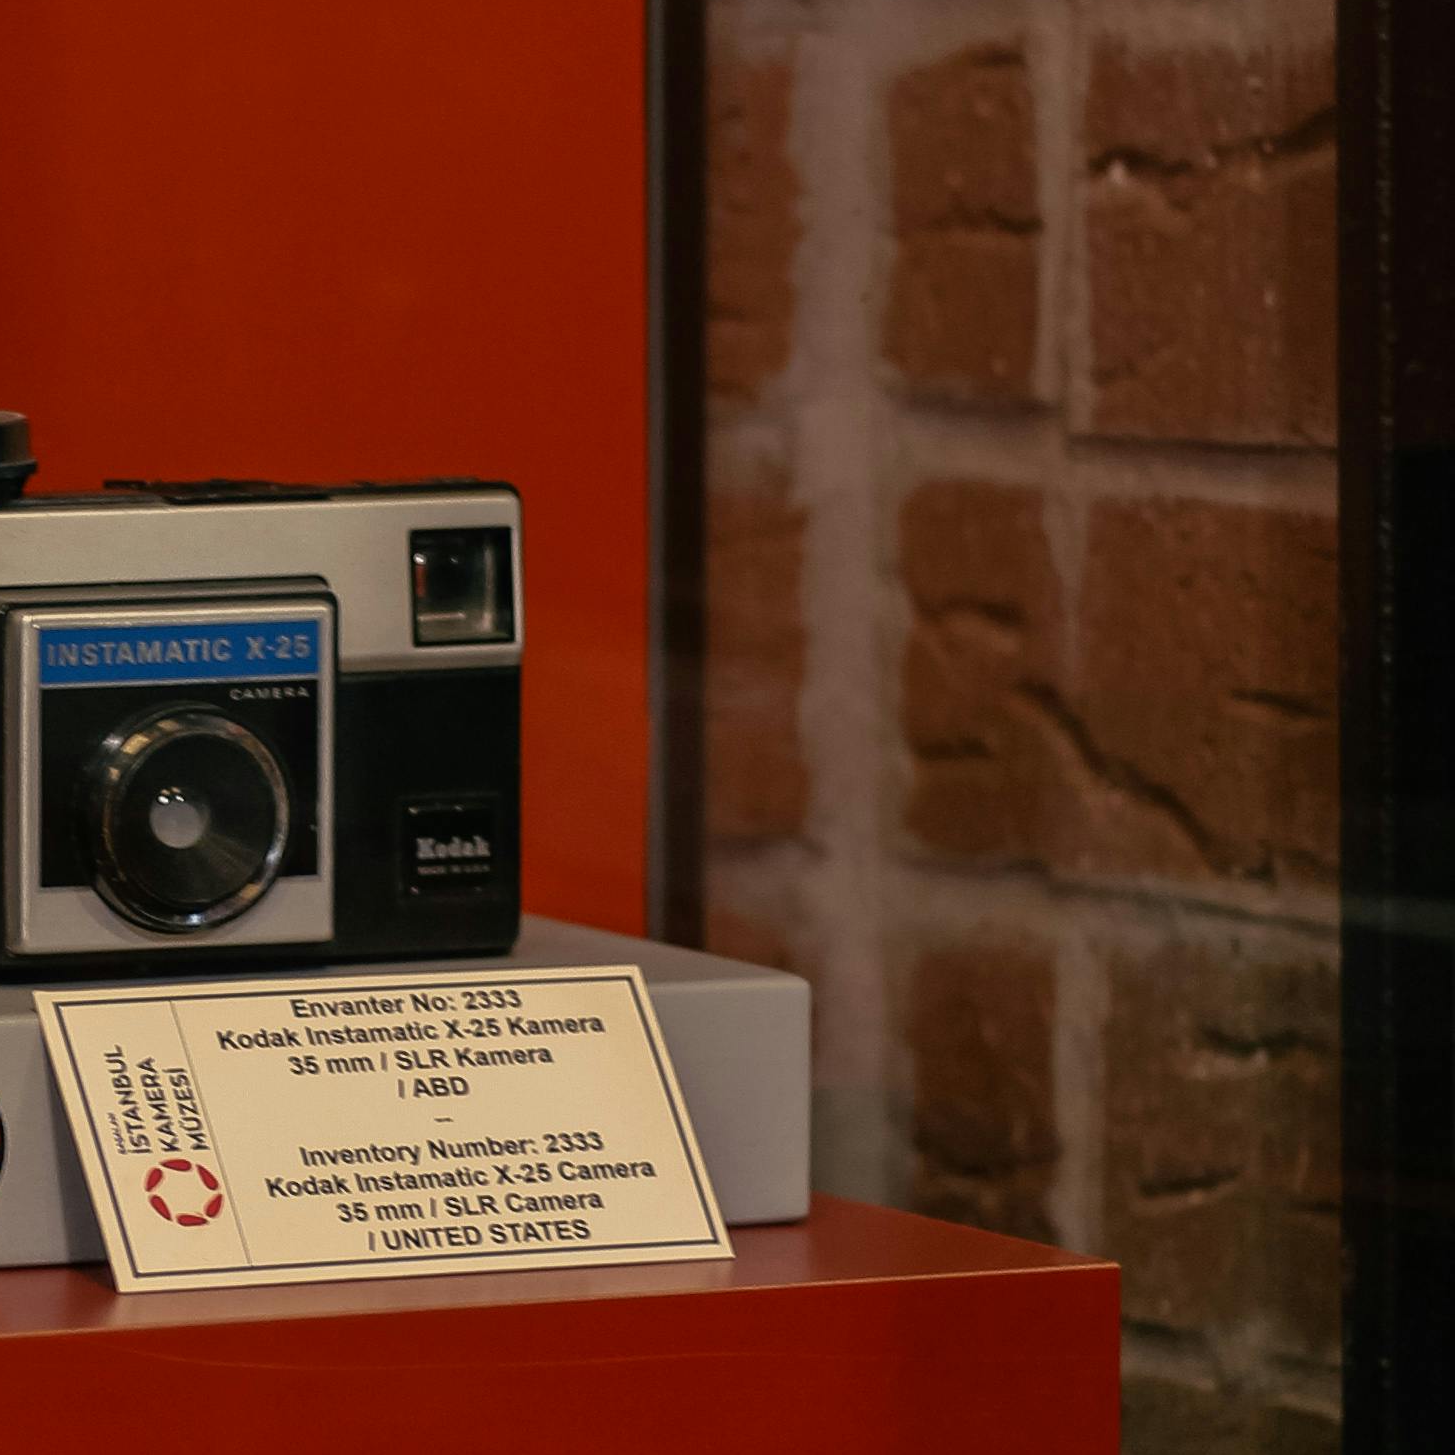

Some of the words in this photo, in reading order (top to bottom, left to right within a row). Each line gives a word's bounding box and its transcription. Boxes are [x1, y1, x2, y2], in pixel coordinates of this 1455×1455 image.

[47, 638, 233, 667] INSTAMATIC
[245, 634, 312, 661] X-25
[229, 685, 311, 701] CAMERA
[416, 835, 491, 859] Kodak
[289, 995, 405, 1018] Envanter
[409, 992, 458, 1013] No:
[460, 989, 523, 1011] 2333
[215, 1027, 303, 1050] Kodak
[304, 1020, 440, 1046] Instamatic
[442, 1017, 501, 1040] X-25
[505, 1016, 606, 1036] Kamera
[287, 1054, 321, 1076] 35
[325, 1054, 376, 1074] mm
[393, 1048, 451, 1071] SLR
[453, 1047, 555, 1067] Kamera
[104, 1044, 153, 1153] İSTANBUL
[413, 1076, 470, 1098] ABD
[136, 1056, 182, 1152] KAMERA
[161, 1067, 210, 1150] MÜZESİ
[299, 1144, 422, 1166] Inventory
[426, 1137, 540, 1160] Number:
[542, 1131, 605, 1153] 2333
[264, 1174, 353, 1198] Kodak
[353, 1167, 490, 1193] Instamatic
[492, 1162, 552, 1185] X-25
[556, 1161, 657, 1181] Camera
[336, 1201, 370, 1223] 35
[374, 1202, 425, 1221] mm
[444, 1195, 500, 1217] SLR
[504, 1192, 605, 1213] Camera
[380, 1225, 483, 1251] UNITED
[488, 1219, 592, 1244] STATES
